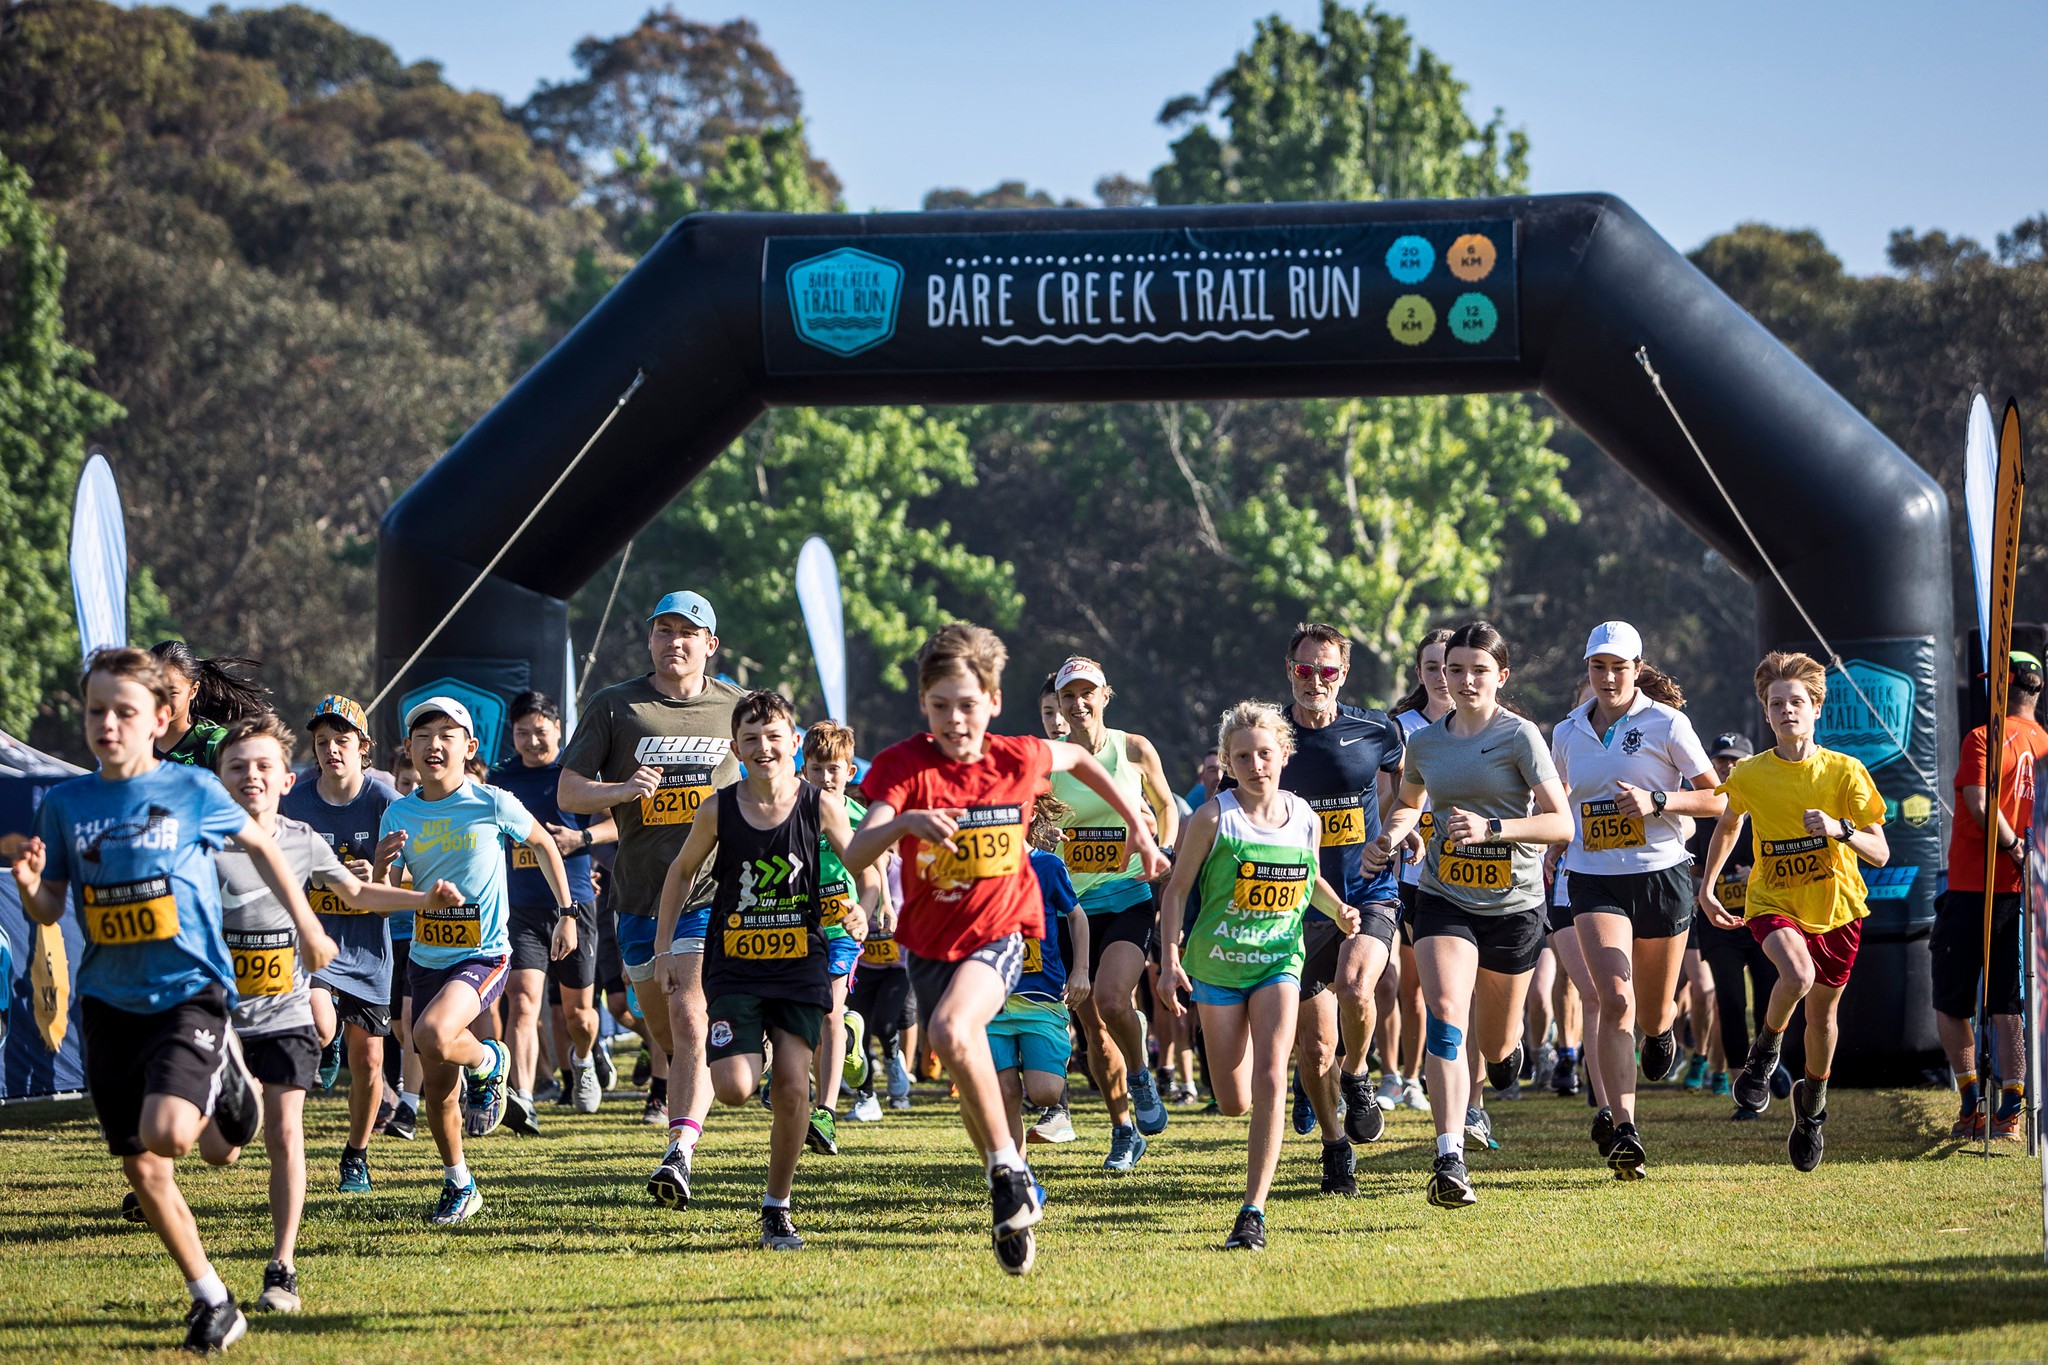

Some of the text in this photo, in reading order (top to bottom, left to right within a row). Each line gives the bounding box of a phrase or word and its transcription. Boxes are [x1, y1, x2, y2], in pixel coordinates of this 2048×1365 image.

[1401, 247, 1419, 257] 20
[1467, 245, 1476, 254] 6
[1400, 259, 1420, 268] KM
[1461, 257, 1482, 267] KM
[809, 271, 880, 288] BARE CREEK
[803, 289, 886, 313] TRAIL RUN
[928, 265, 1360, 327] BARE CREEK TRAIL RUN
[1407, 307, 1415, 318] 2
[1465, 305, 1479, 316] 12
[1401, 321, 1422, 331] KM
[1463, 319, 1483, 330] KM
[1826, 687, 1849, 704] ARE
[669, 775, 684, 783] CREEK
[685, 774, 697, 782] TRAIL
[653, 790, 700, 812] 6210
[420, 819, 452, 838] JUST
[1321, 813, 1353, 834] 164
[1591, 817, 1632, 839] 6156
[442, 832, 478, 852] DO IT
[955, 832, 1010, 861] 6139
[1073, 845, 1117, 862] 6089
[1483, 847, 1496, 855] TRAIL
[1257, 866, 1270, 875] BARE
[1271, 867, 1287, 876] CREEK
[1450, 862, 1498, 884] 6018
[1775, 854, 1819, 877] 6102
[758, 898, 777, 907] UN
[759, 889, 776, 902] THE
[1249, 885, 1296, 907] 6081
[452, 908, 466, 916] TRAIL
[821, 899, 840, 917] 29
[101, 907, 156, 938] 6110
[744, 915, 756, 924] BARE
[758, 915, 775, 923] CREEK
[776, 914, 790, 922] TRAIL
[423, 924, 467, 945] 6182
[736, 932, 796, 956] 6099
[234, 955, 280, 980] 096
[461, 970, 480, 981] FILA
